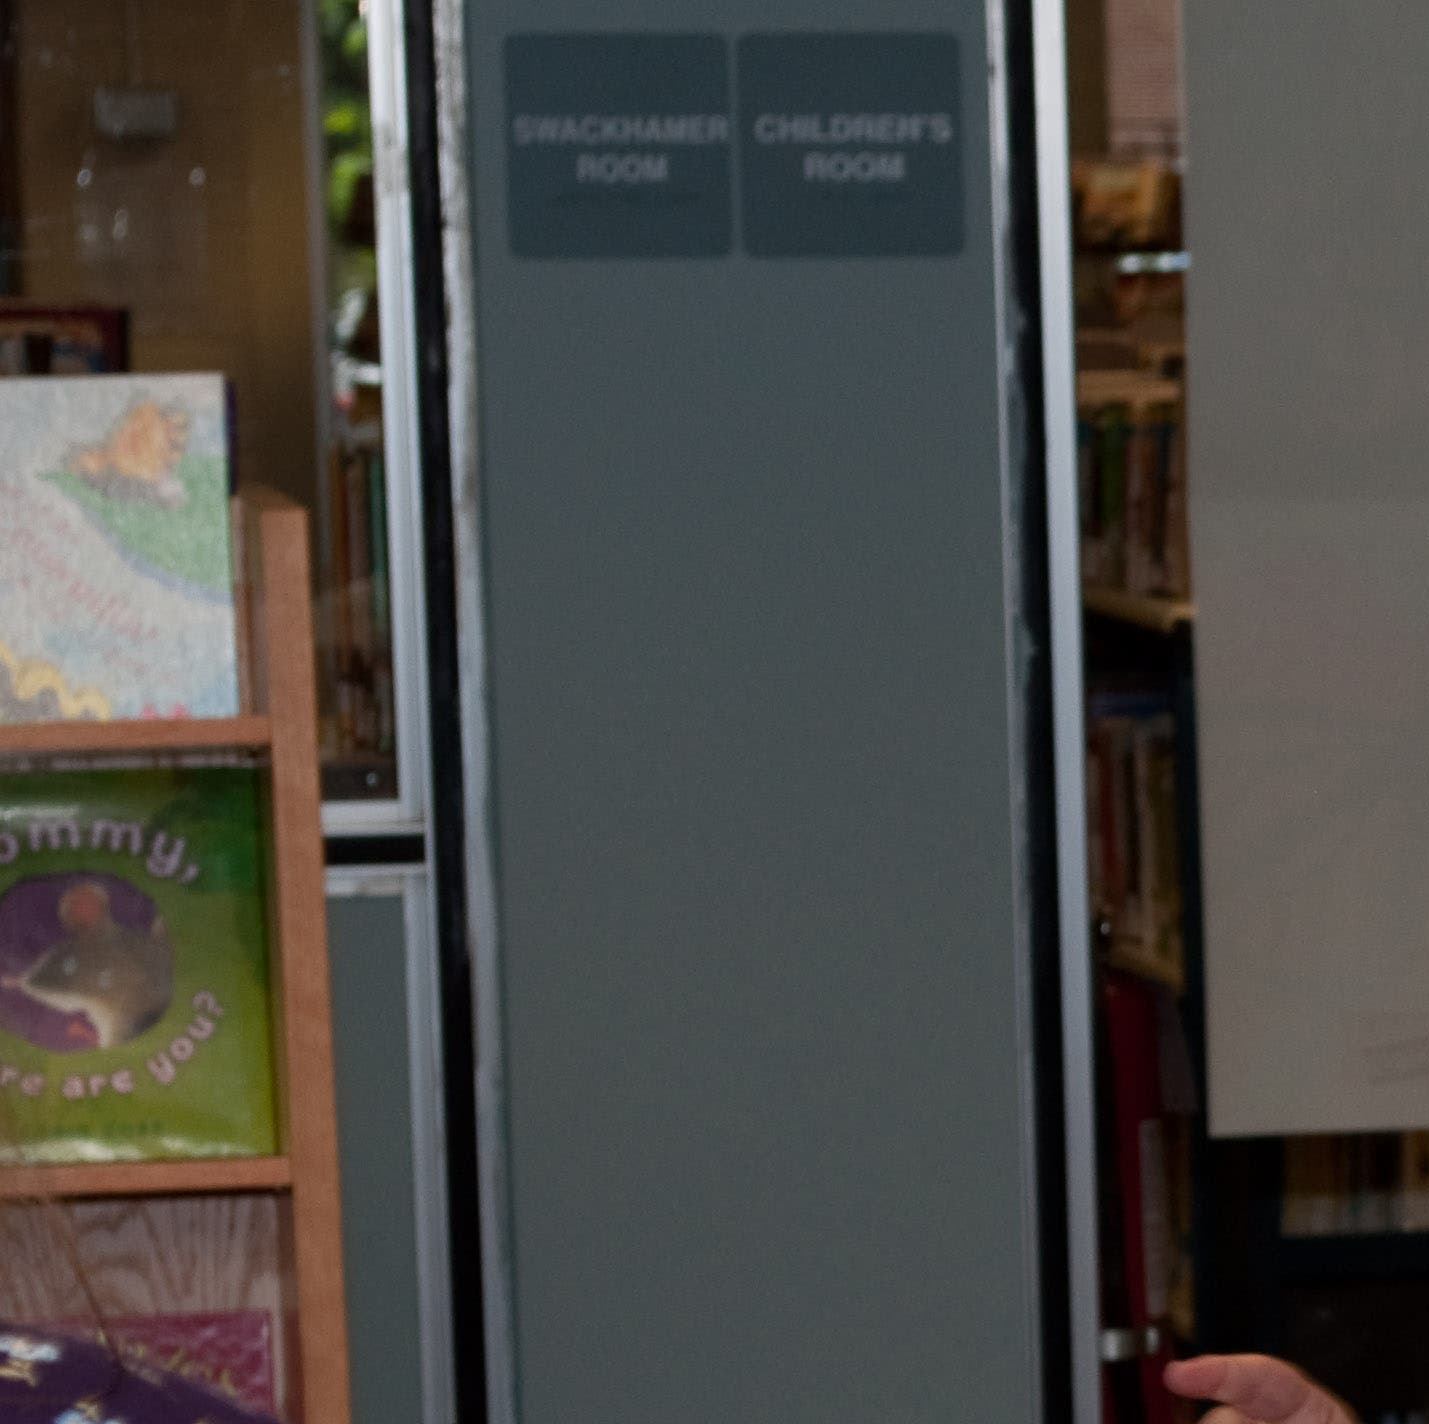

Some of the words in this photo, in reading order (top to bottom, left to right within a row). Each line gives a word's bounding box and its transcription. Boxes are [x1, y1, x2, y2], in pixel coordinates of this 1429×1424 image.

[512, 113, 729, 146] SWACKHAMER
[753, 112, 953, 144] CHILDREN'S
[576, 153, 668, 182] ROOM
[803, 151, 905, 182] ROOM
[62, 1069, 134, 1100] are
[146, 990, 223, 1085] you?
